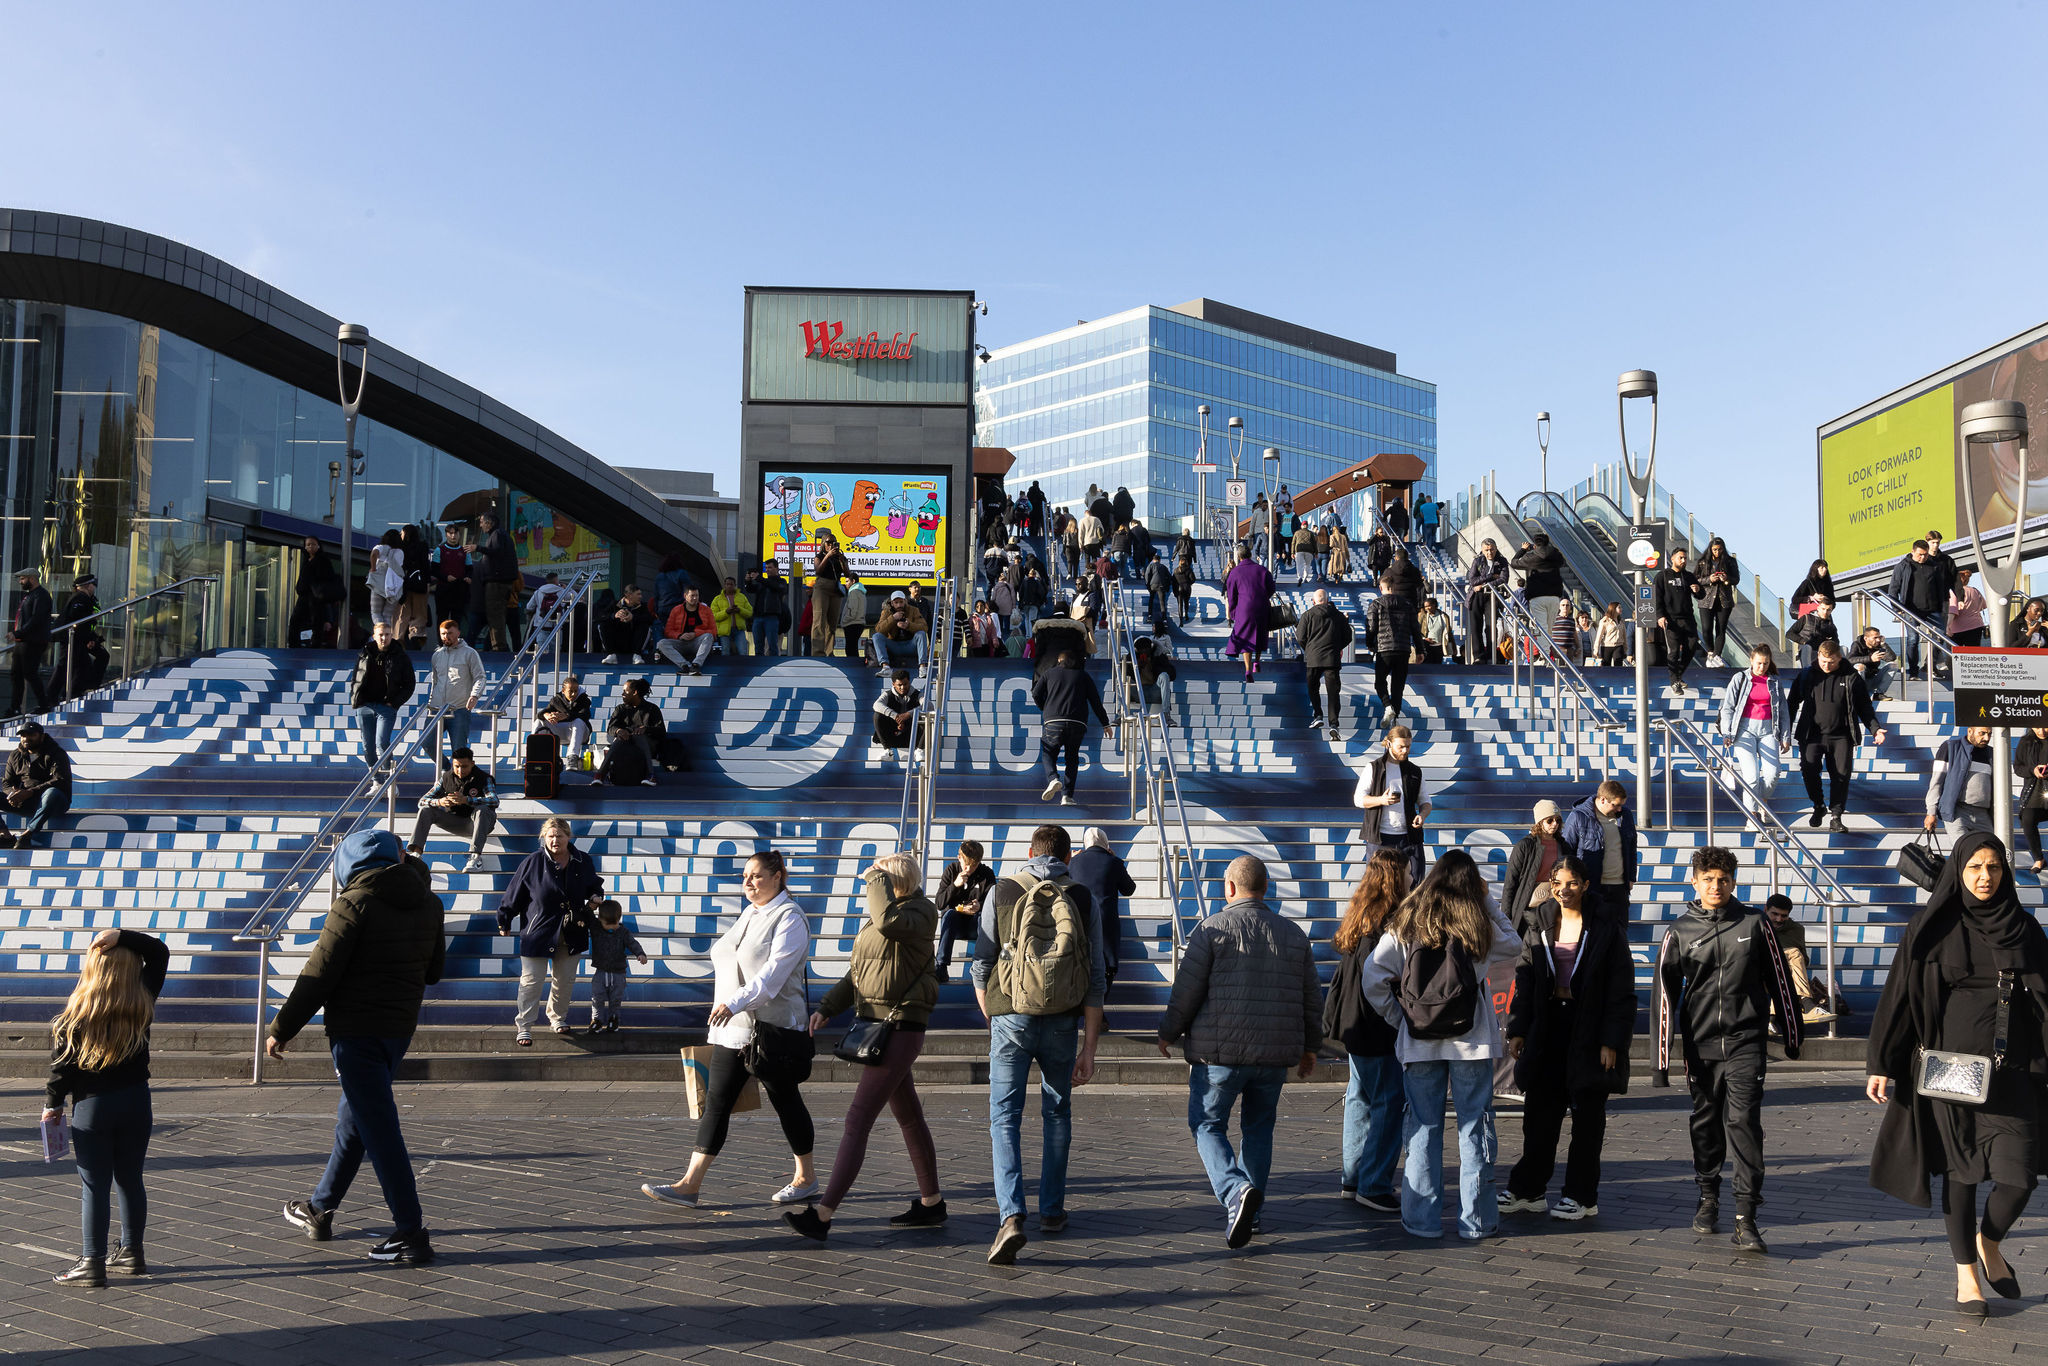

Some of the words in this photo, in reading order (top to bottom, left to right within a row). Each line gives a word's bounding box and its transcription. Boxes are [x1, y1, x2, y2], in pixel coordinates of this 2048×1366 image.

[798, 320, 918, 360] Westfield
[1847, 465, 1873, 486] LOOK
[1875, 446, 1922, 475] FORWARD
[1861, 486, 1874, 501] TO
[1876, 472, 1908, 496] CHILLY
[1848, 502, 1884, 525] WINTER
[1887, 489, 1923, 513] NIGHTS
[777, 556, 815, 566] CIGRETTE
[858, 558, 879, 566] MADE
[880, 558, 901, 567] FROM
[903, 559, 933, 567] PLASTIC
[1995, 694, 2041, 706] Maryland
[2005, 707, 2042, 717] Station
